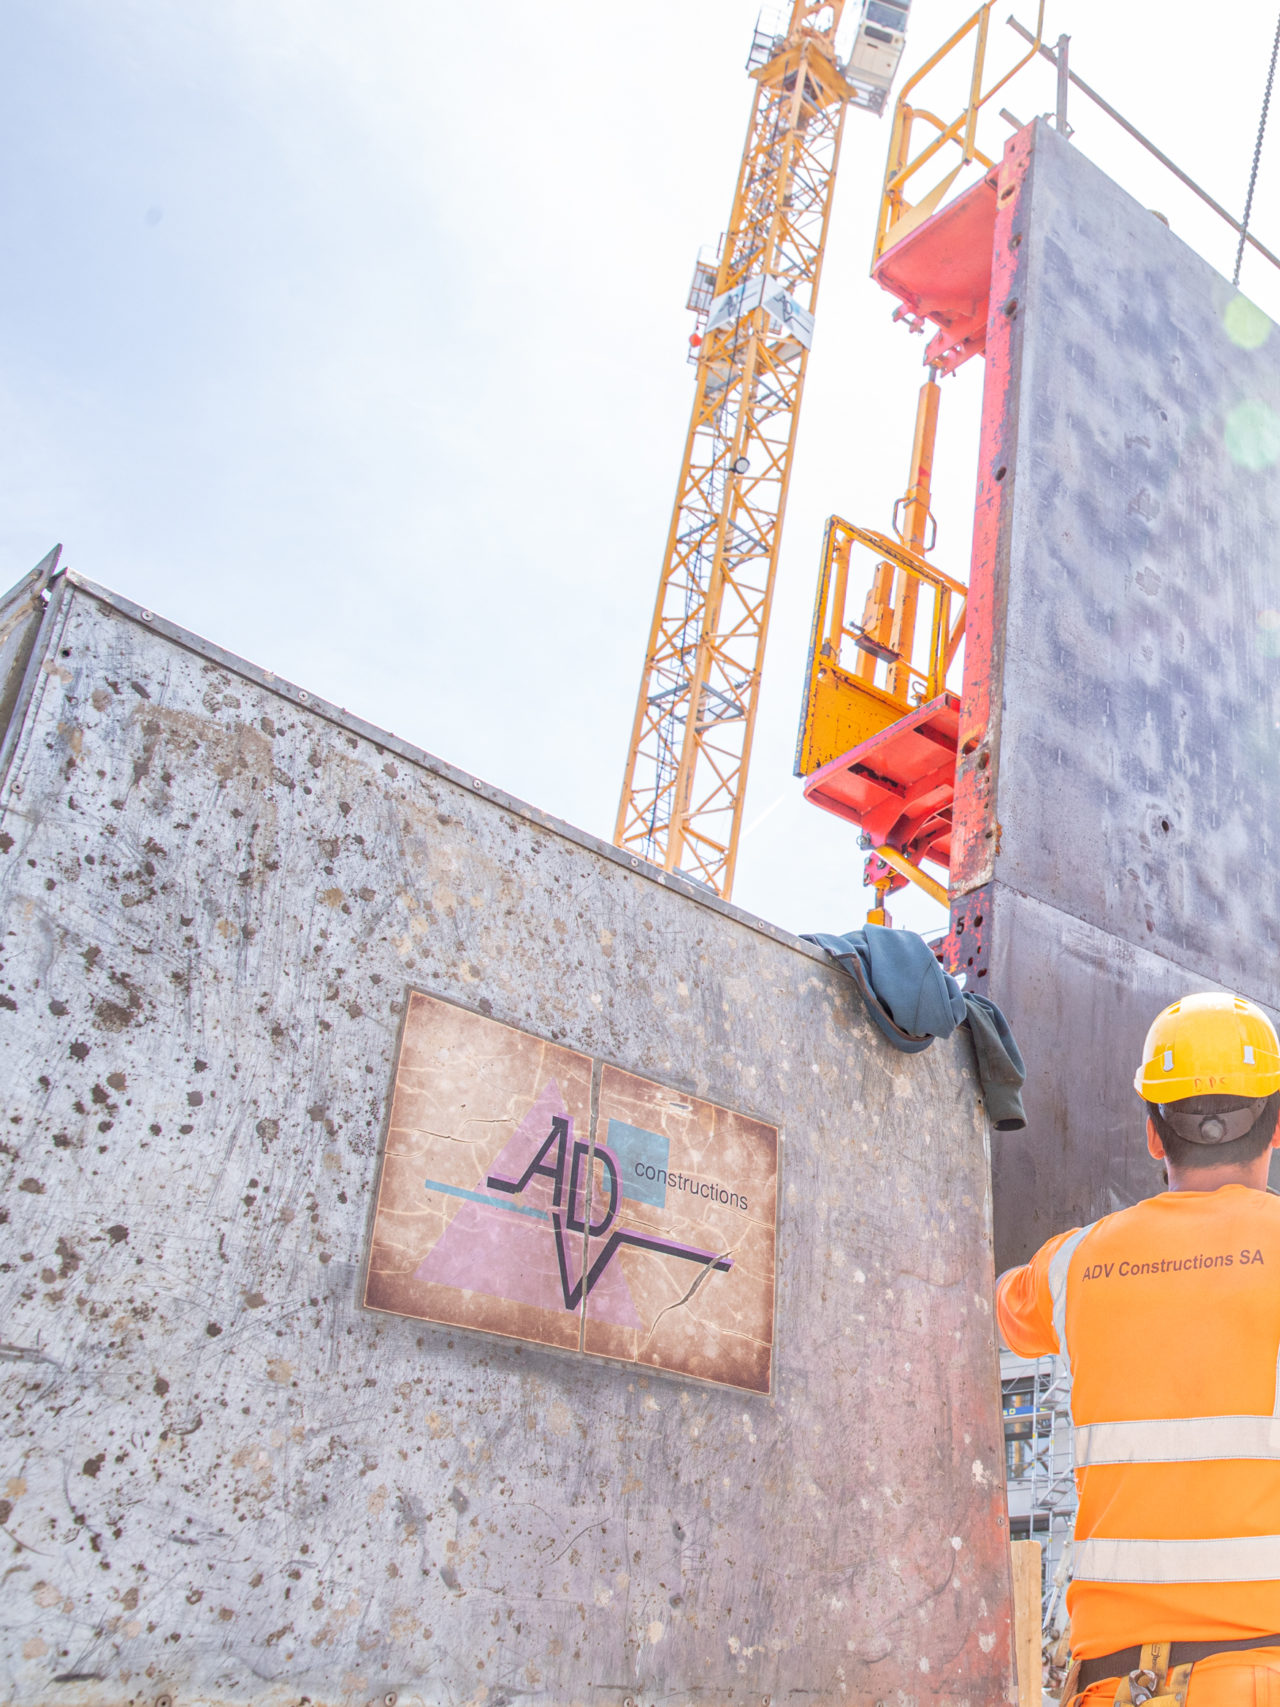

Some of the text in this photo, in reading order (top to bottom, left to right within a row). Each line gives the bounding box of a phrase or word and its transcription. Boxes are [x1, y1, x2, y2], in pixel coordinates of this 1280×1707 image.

[956, 915, 965, 936] 5
[634, 1160, 749, 1211] constructions
[1081, 1249, 1265, 1282] ADV Constructions SA
